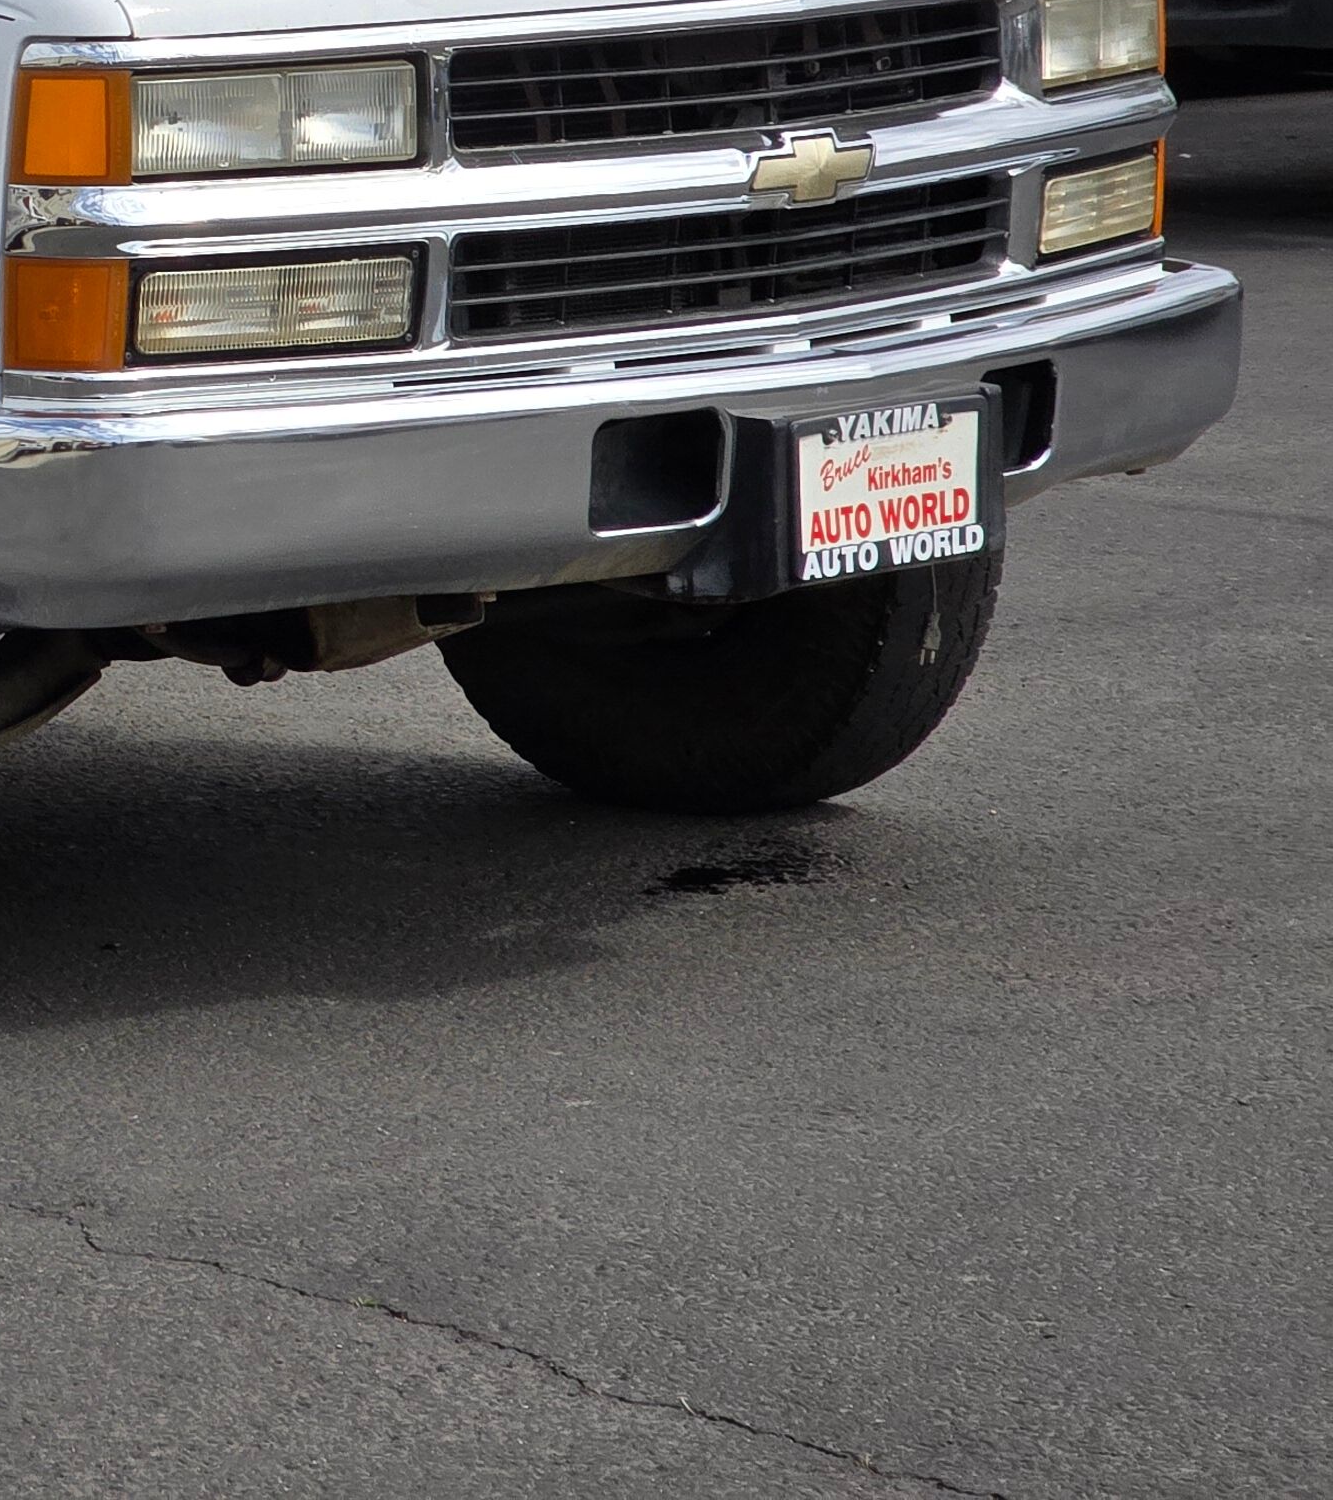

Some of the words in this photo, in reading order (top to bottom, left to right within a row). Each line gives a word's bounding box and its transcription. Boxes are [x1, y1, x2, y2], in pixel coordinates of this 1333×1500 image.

[838, 403, 939, 443] YAKIMA
[820, 444, 872, 491] Bruce
[867, 457, 952, 491] Kirkham's
[810, 503, 872, 547] AUTO
[878, 487, 969, 534] WORLD
[802, 542, 878, 580] AUTO
[889, 524, 984, 565] WORLD
